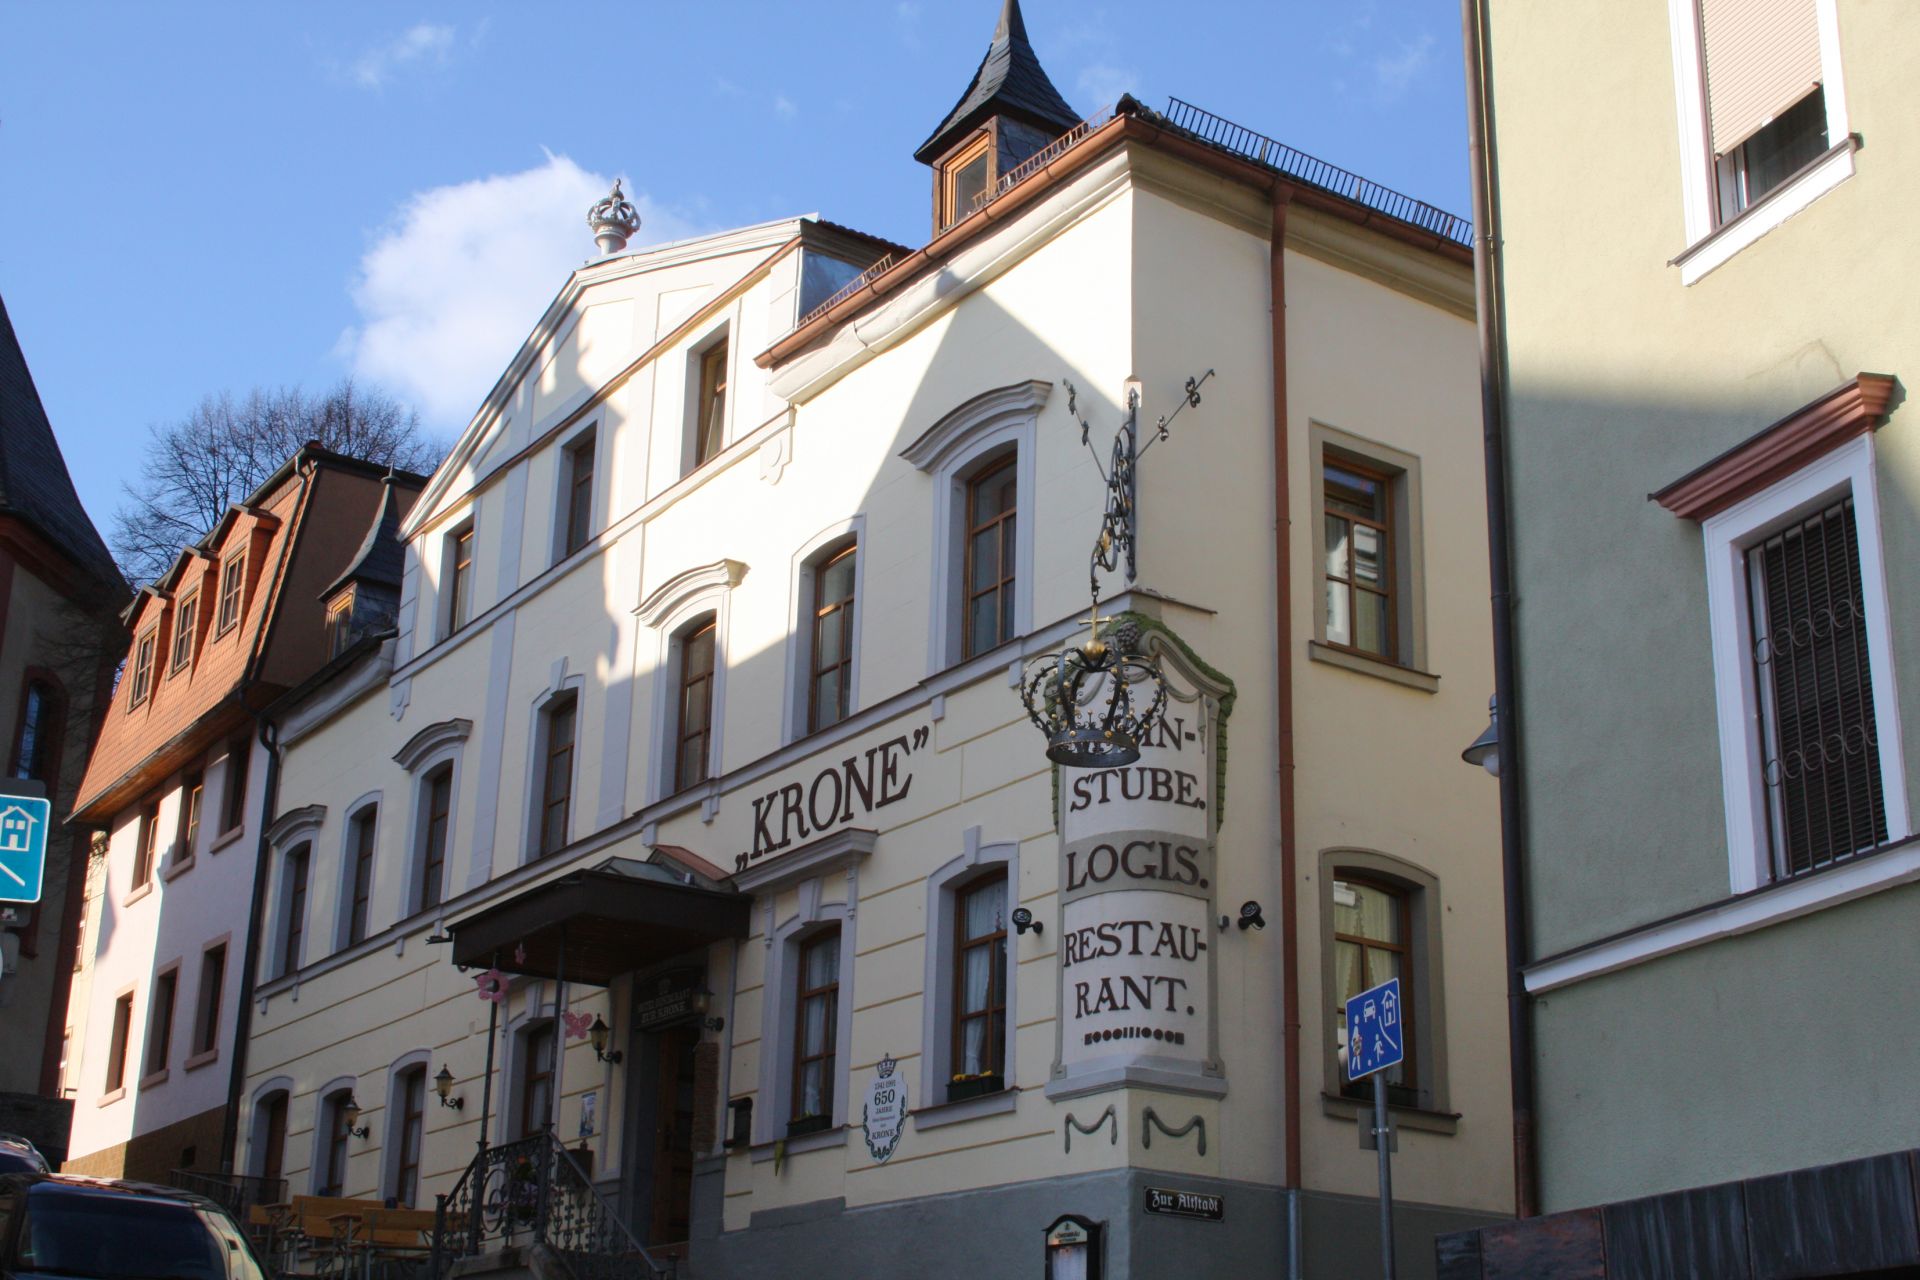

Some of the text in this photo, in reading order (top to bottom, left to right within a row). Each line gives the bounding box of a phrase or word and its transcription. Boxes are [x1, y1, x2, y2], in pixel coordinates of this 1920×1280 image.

[1070, 767, 1207, 812] STUBE.
[1066, 841, 1209, 892] LOGIS.
[1063, 920, 1208, 968] RESTAU-
[1075, 976, 1195, 1019] RANT.
[874, 1089, 895, 1106] 650
[871, 1127, 895, 1140] KRONE
[1151, 1190, 1173, 1208] Zur
